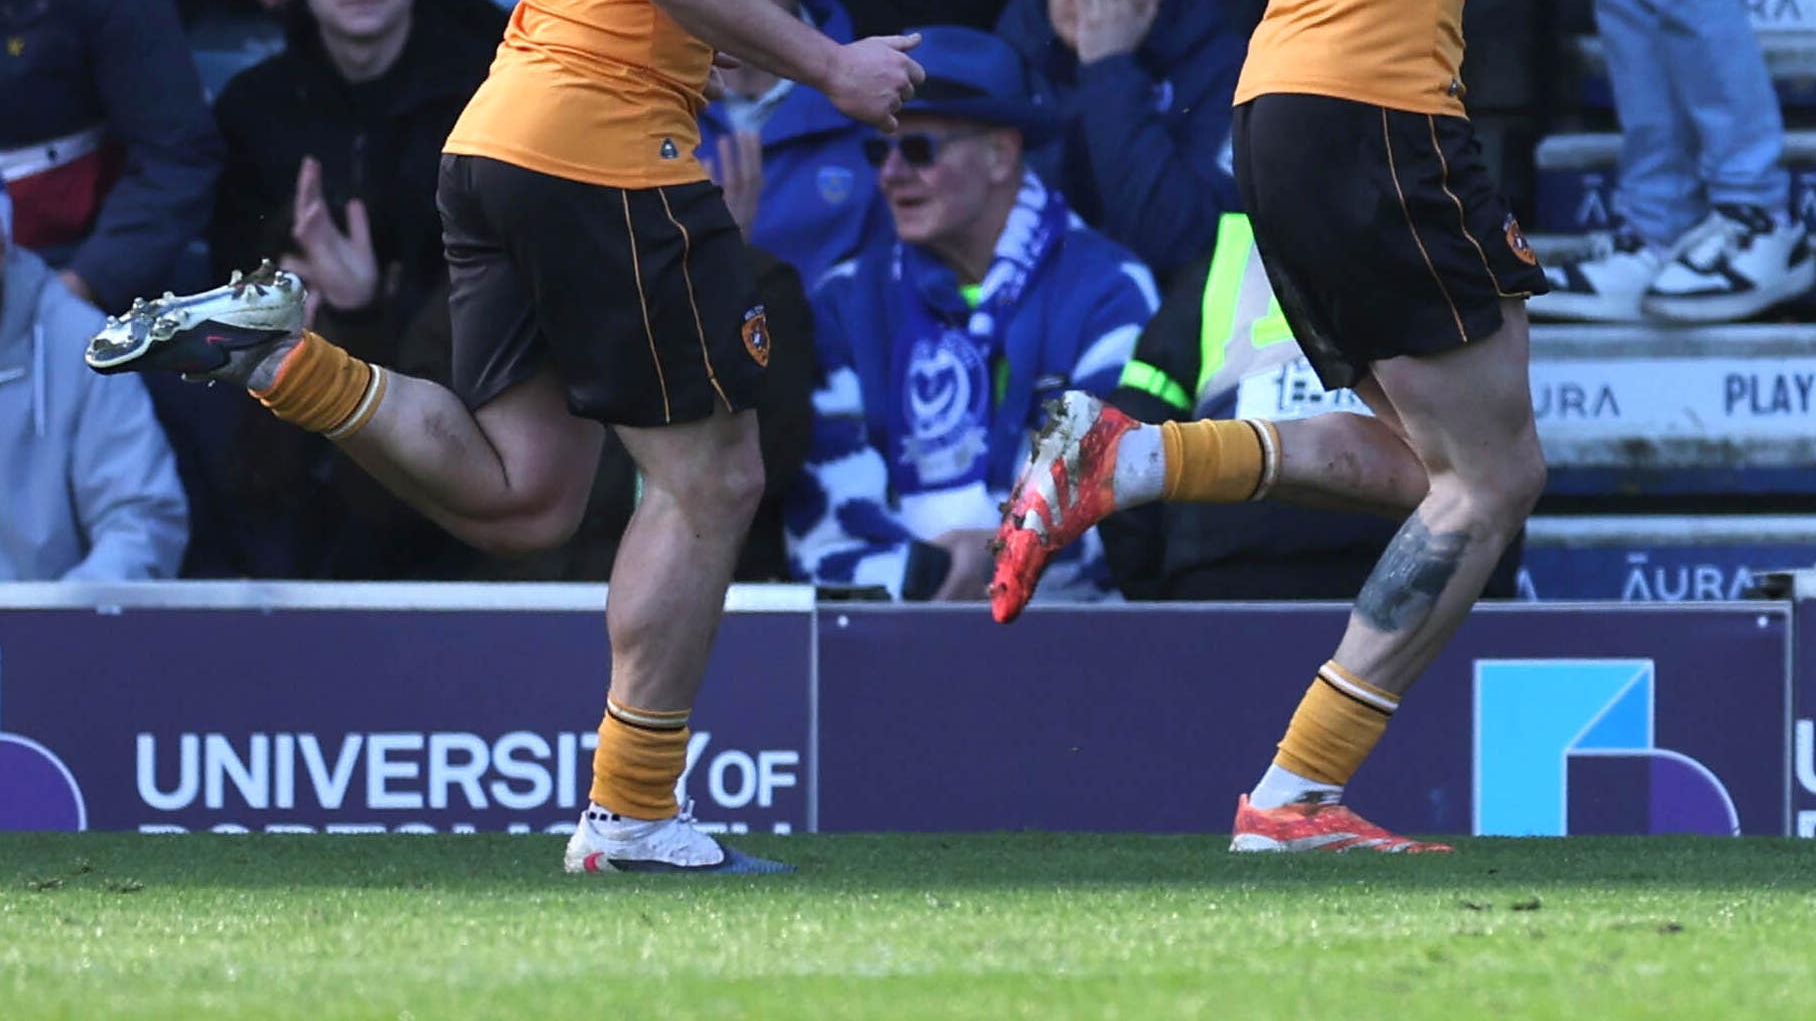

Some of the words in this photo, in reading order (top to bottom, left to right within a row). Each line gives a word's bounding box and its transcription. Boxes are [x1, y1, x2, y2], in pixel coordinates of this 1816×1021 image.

[1534, 383, 1621, 418] URA
[1725, 373, 1815, 416] PLAY
[137, 732, 712, 809] UNIVERSI
[708, 751, 799, 808] OF
